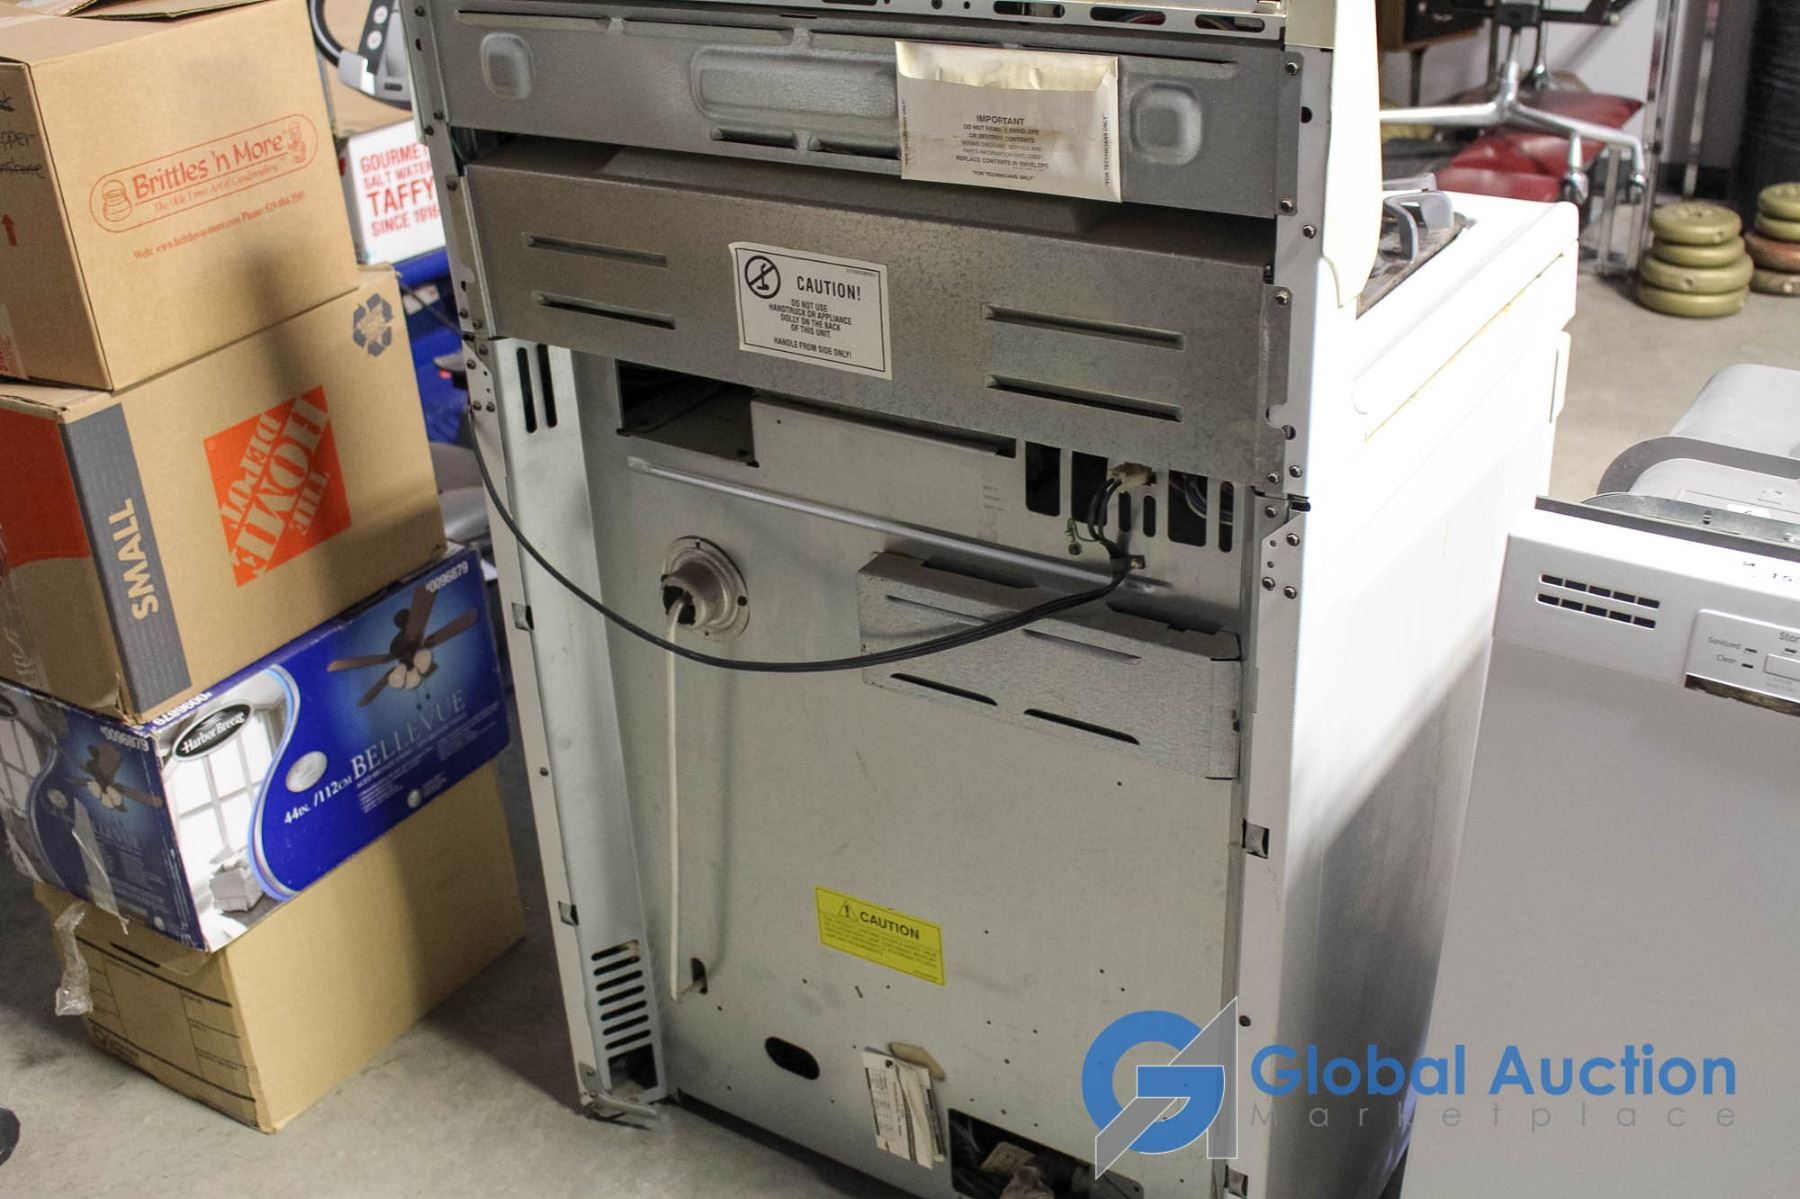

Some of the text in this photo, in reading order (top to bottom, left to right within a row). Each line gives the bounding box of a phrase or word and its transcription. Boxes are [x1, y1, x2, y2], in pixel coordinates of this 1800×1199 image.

[976, 115, 1024, 125] IMPORTANT
[131, 159, 209, 200] Brittles
[232, 134, 283, 165] More
[367, 177, 434, 216] TAFFY
[371, 212, 410, 237] SINCE
[797, 275, 861, 301] CAUTION!
[768, 303, 852, 325] HANDTRUCK OR APPLIANCE
[791, 298, 828, 312] DO NOT USE
[780, 313, 841, 331] DOLLY ON THE BACK
[791, 323, 799, 331] OF
[800, 325, 815, 335] THIS
[774, 336, 798, 348] HANDLE
[799, 341, 817, 351] FROM
[818, 344, 833, 355] SIDE
[220, 413, 282, 530] DEPOT
[232, 399, 329, 575] HOME
[288, 471, 330, 535] THE
[108, 498, 159, 620] SMALL
[181, 728, 216, 754] Harbor
[350, 689, 466, 780] BELLEVUE
[860, 911, 920, 939] CAUTION
